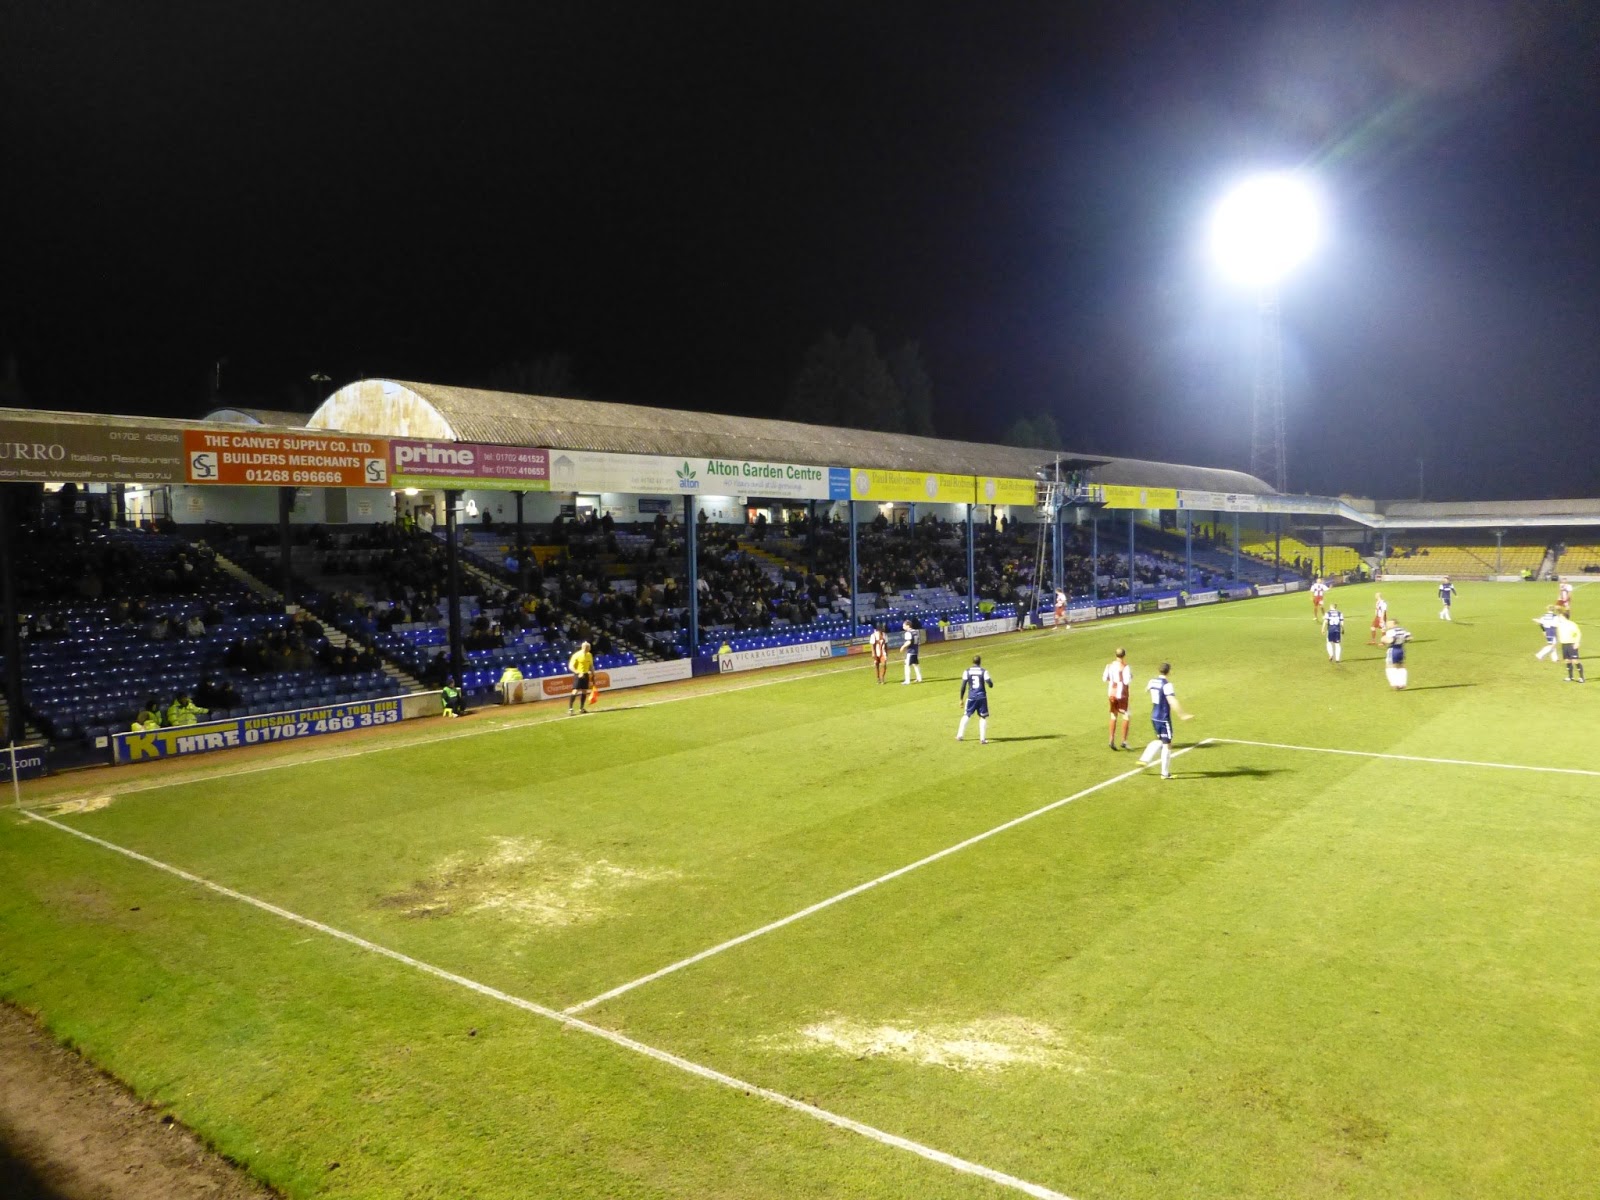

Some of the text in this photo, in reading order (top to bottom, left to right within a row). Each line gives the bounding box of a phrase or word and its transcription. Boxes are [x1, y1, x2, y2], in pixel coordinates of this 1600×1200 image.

[205, 436, 375, 453] THE CANVEY SUPPLY CO. LTD.
[71, 454, 180, 465] Italian Restaurant
[223, 453, 360, 468] BUILDERS MERCHANTS
[395, 444, 474, 466] prime
[496, 454, 517, 462] 01702
[246, 470, 342, 483] 01268 696666
[496, 466, 517, 475] 01702
[707, 460, 822, 481] Alton Garden Centre
[679, 480, 699, 488] alton
[972, 675, 980, 689] 3
[245, 716, 296, 730] KURSAAL
[301, 709, 333, 722] PLANT
[348, 704, 372, 716] TOOL
[375, 701, 398, 712] HIRE
[245, 710, 398, 743] 01702 466 353
[177, 730, 239, 754] HIRE
